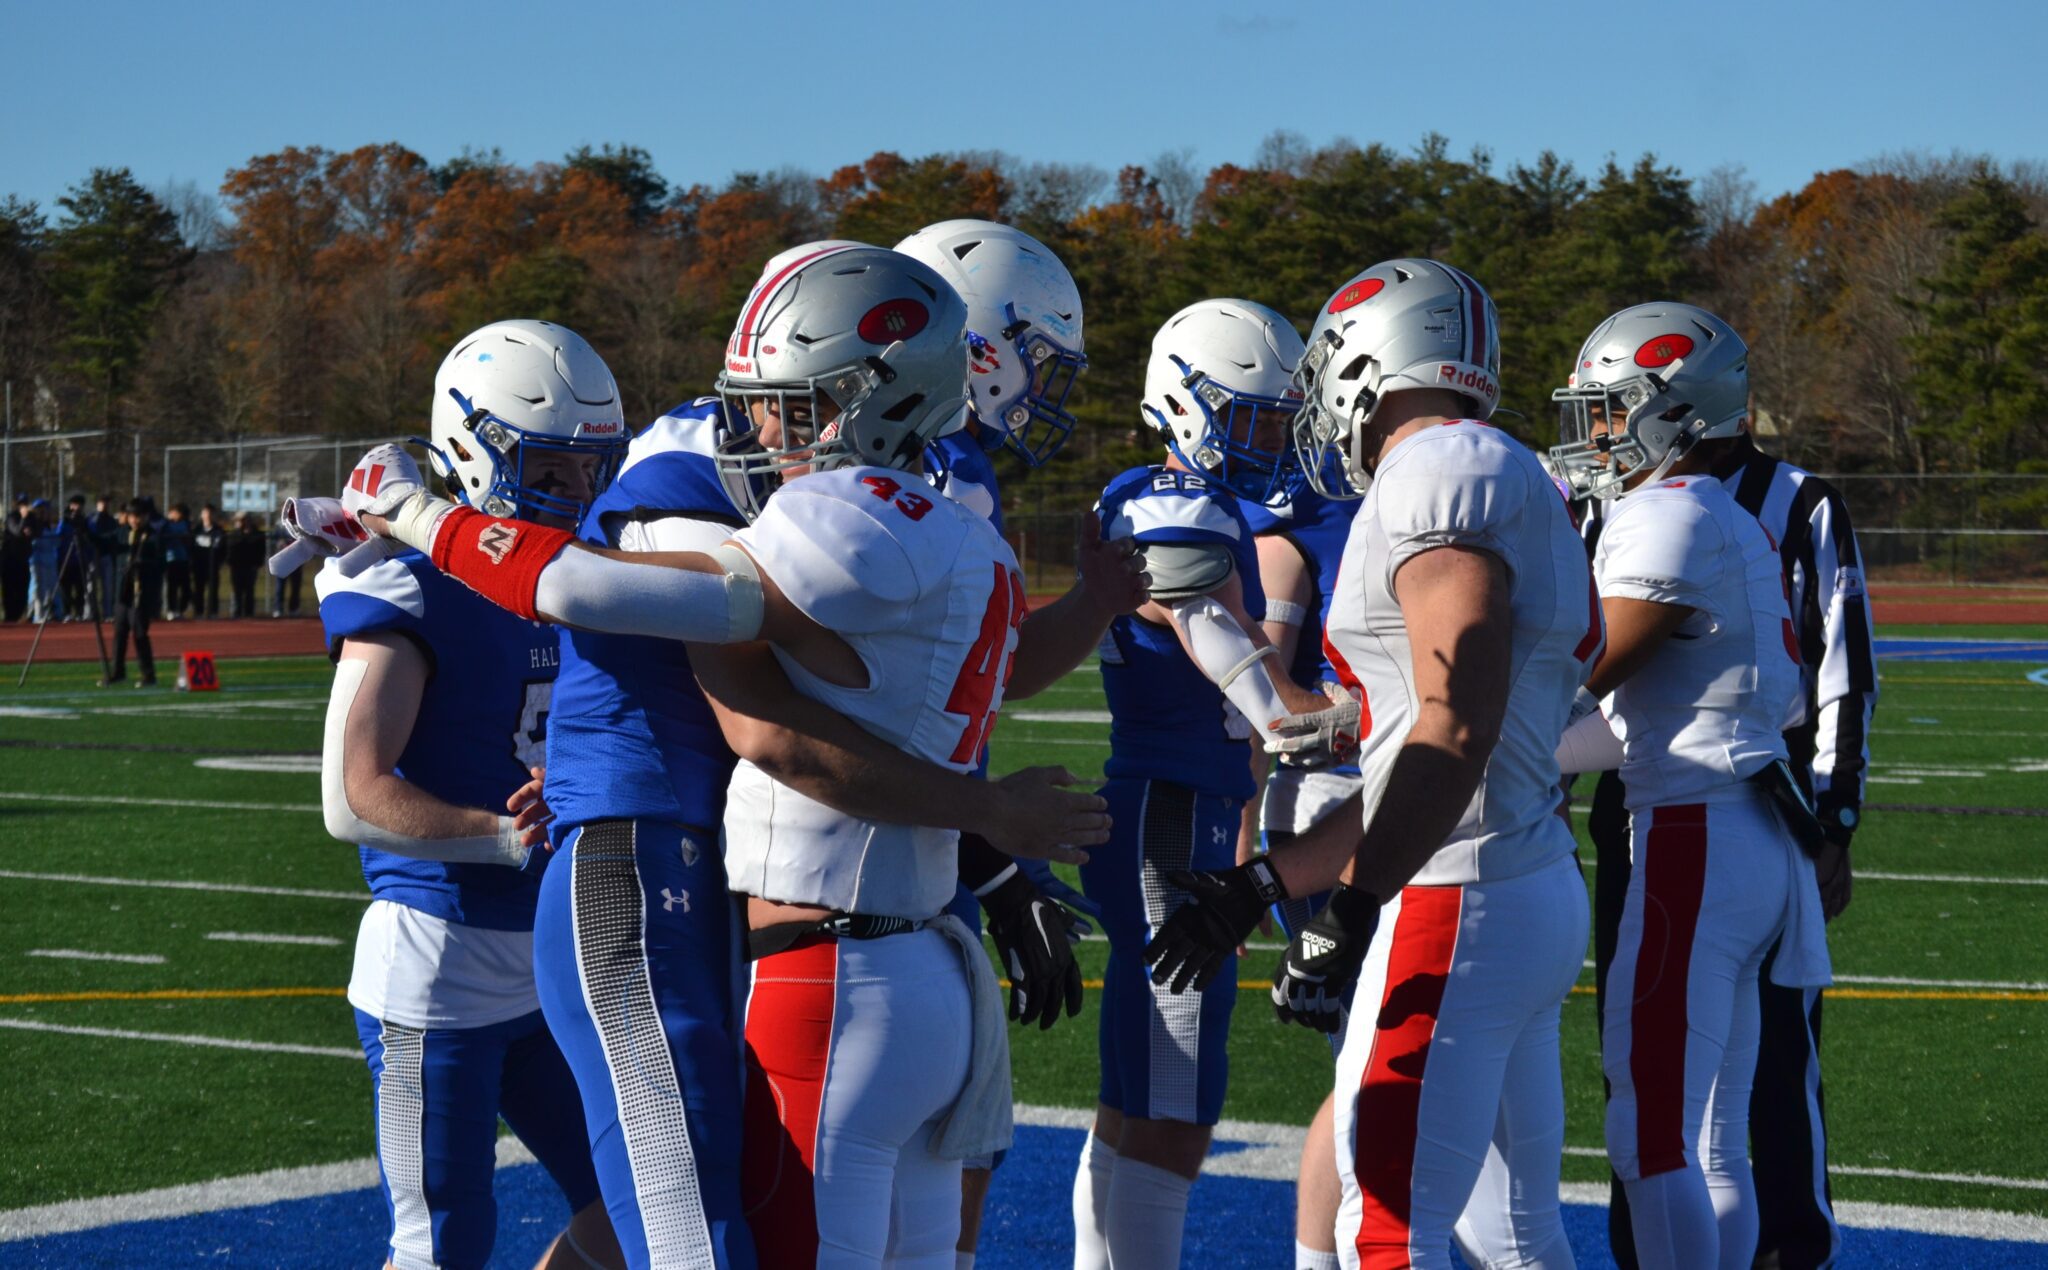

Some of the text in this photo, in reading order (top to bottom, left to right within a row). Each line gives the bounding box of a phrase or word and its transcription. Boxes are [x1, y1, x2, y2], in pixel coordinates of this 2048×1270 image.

[583, 422, 619, 434] Riddell
[1152, 473, 1207, 492] 22
[862, 475, 935, 522] 43
[530, 646, 561, 669] HAL
[187, 656, 215, 686] 20
[1301, 930, 1336, 949] adidas
